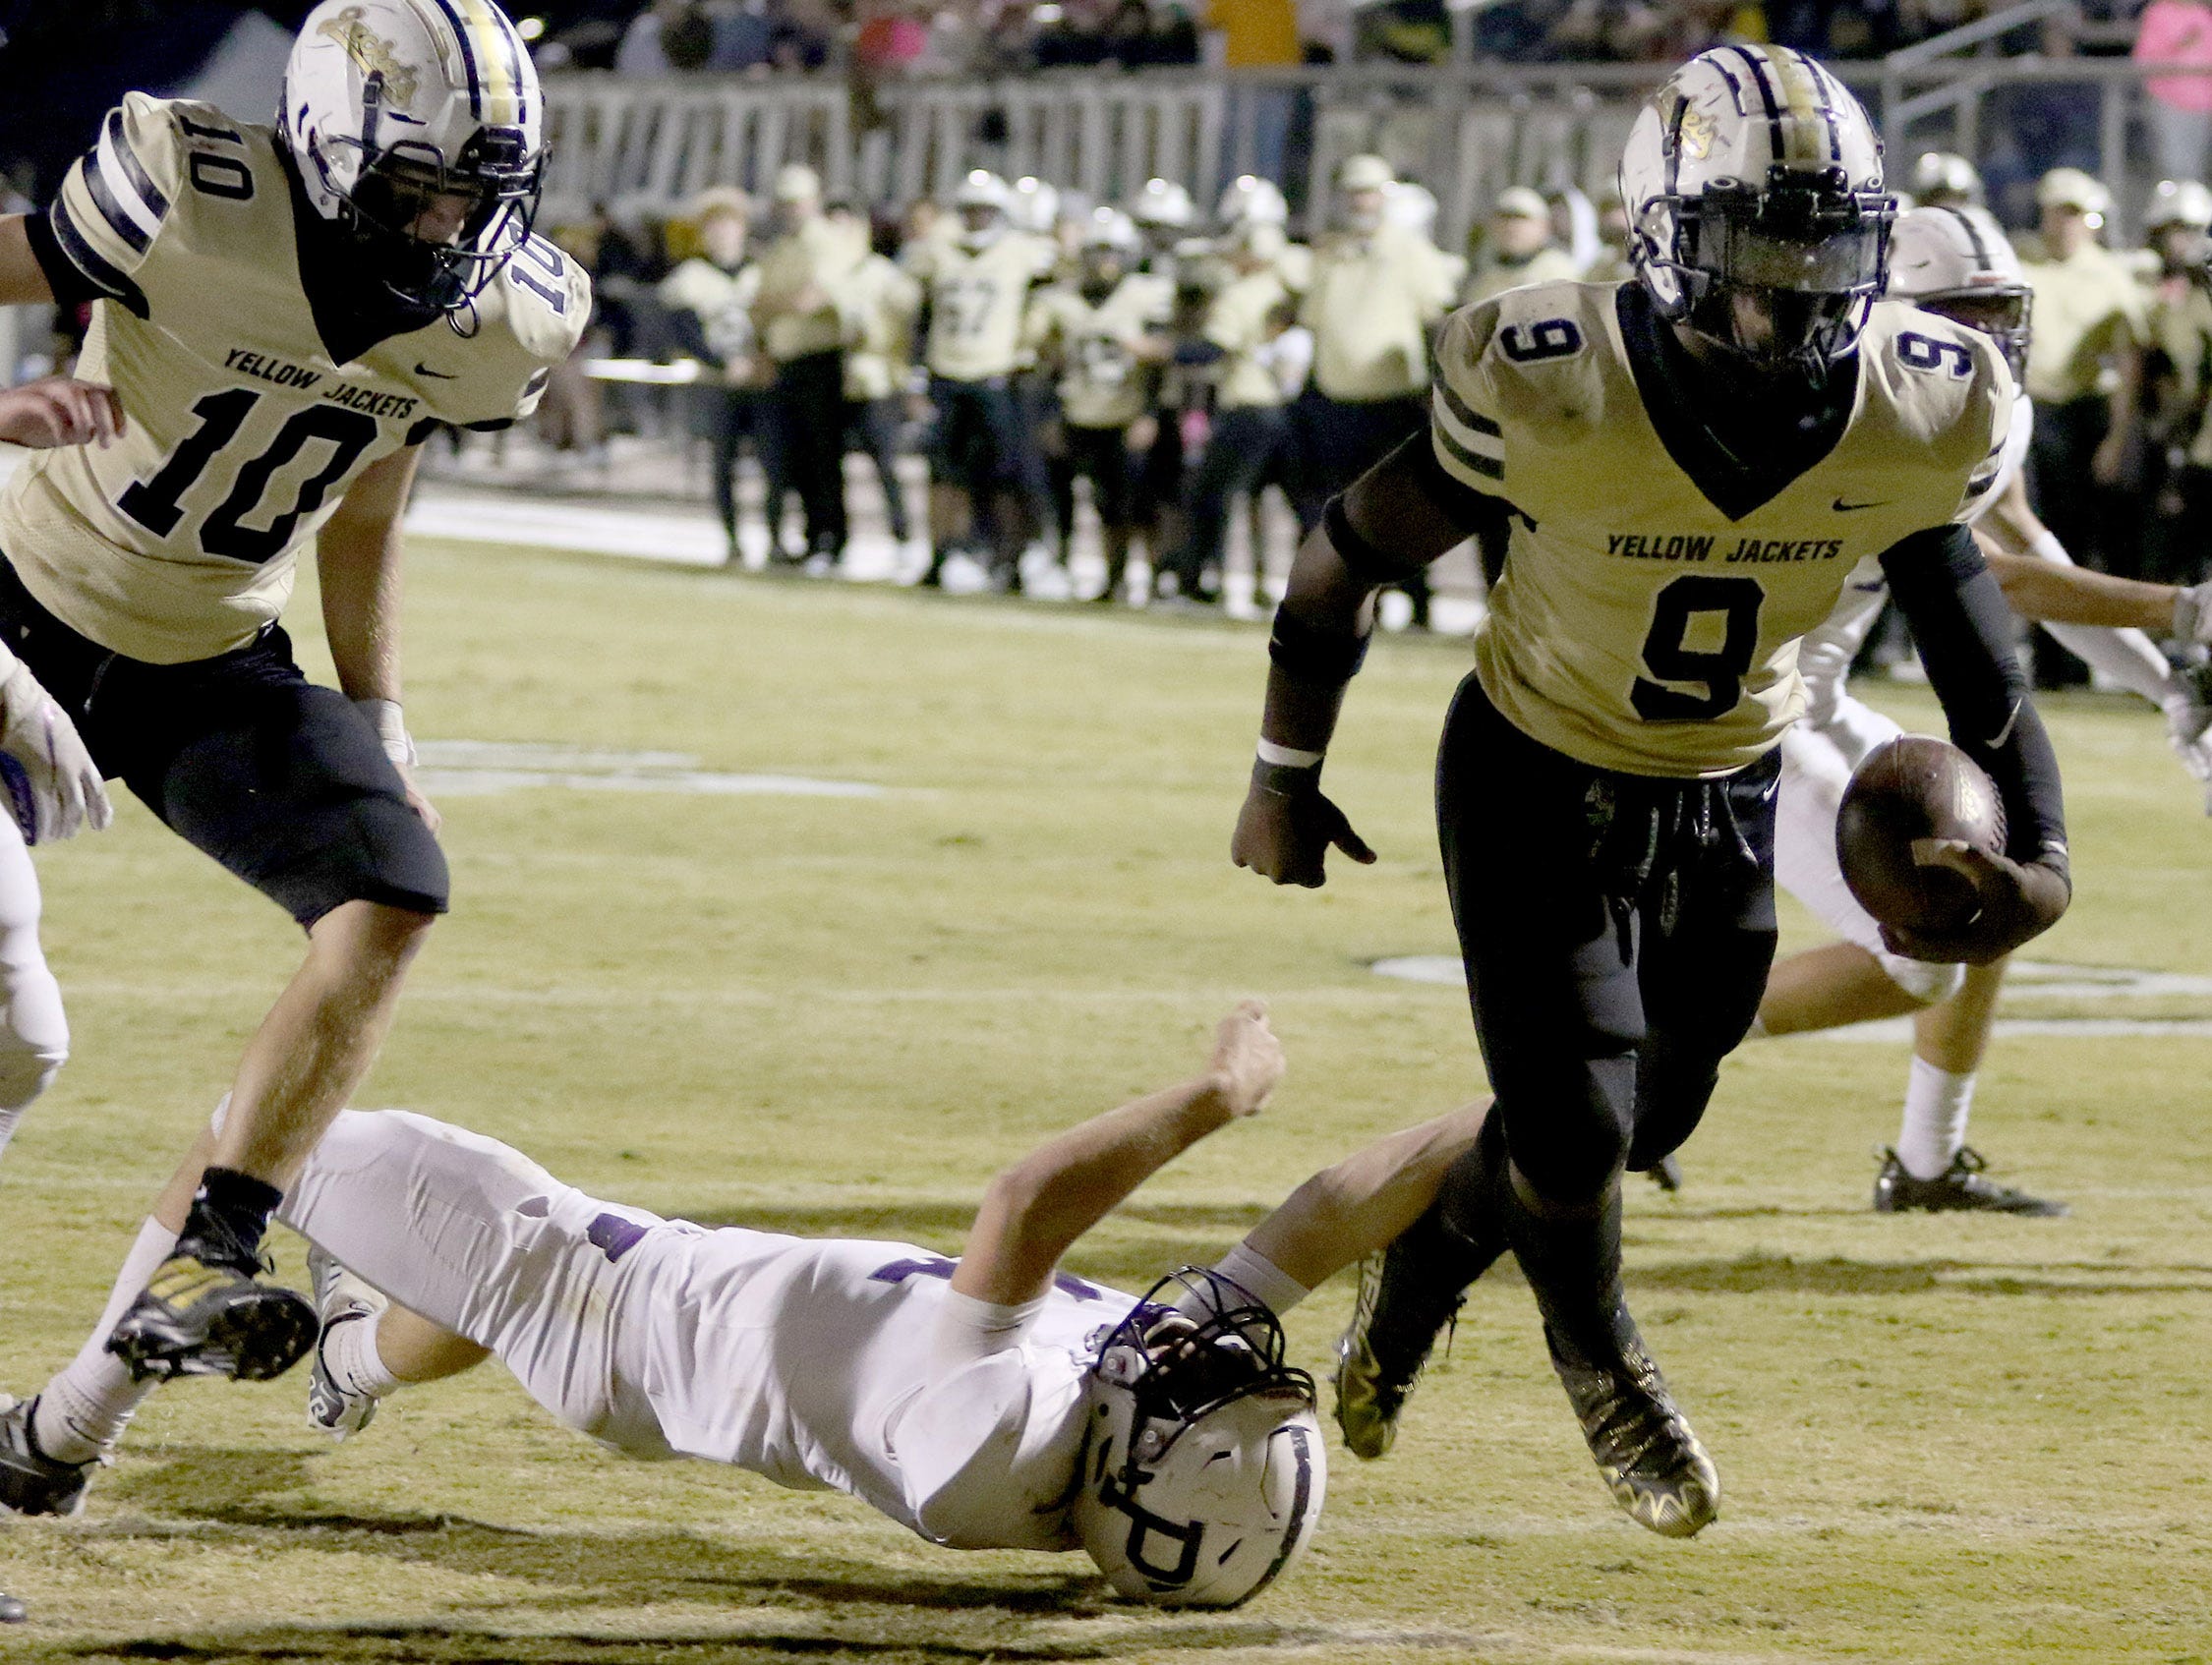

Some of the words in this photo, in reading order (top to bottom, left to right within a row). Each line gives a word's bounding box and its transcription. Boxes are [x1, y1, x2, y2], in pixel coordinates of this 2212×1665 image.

[179, 114, 255, 201] 10
[507, 222, 565, 315] 10
[1499, 317, 1582, 363] 9
[1896, 330, 1973, 376] 9
[224, 348, 322, 390] YELLOW
[322, 382, 420, 420] JACKETS
[116, 387, 378, 564] 10
[1608, 534, 1716, 562] YELLOW
[1724, 538, 1843, 564] JACKETS
[1629, 575, 1766, 721] 9
